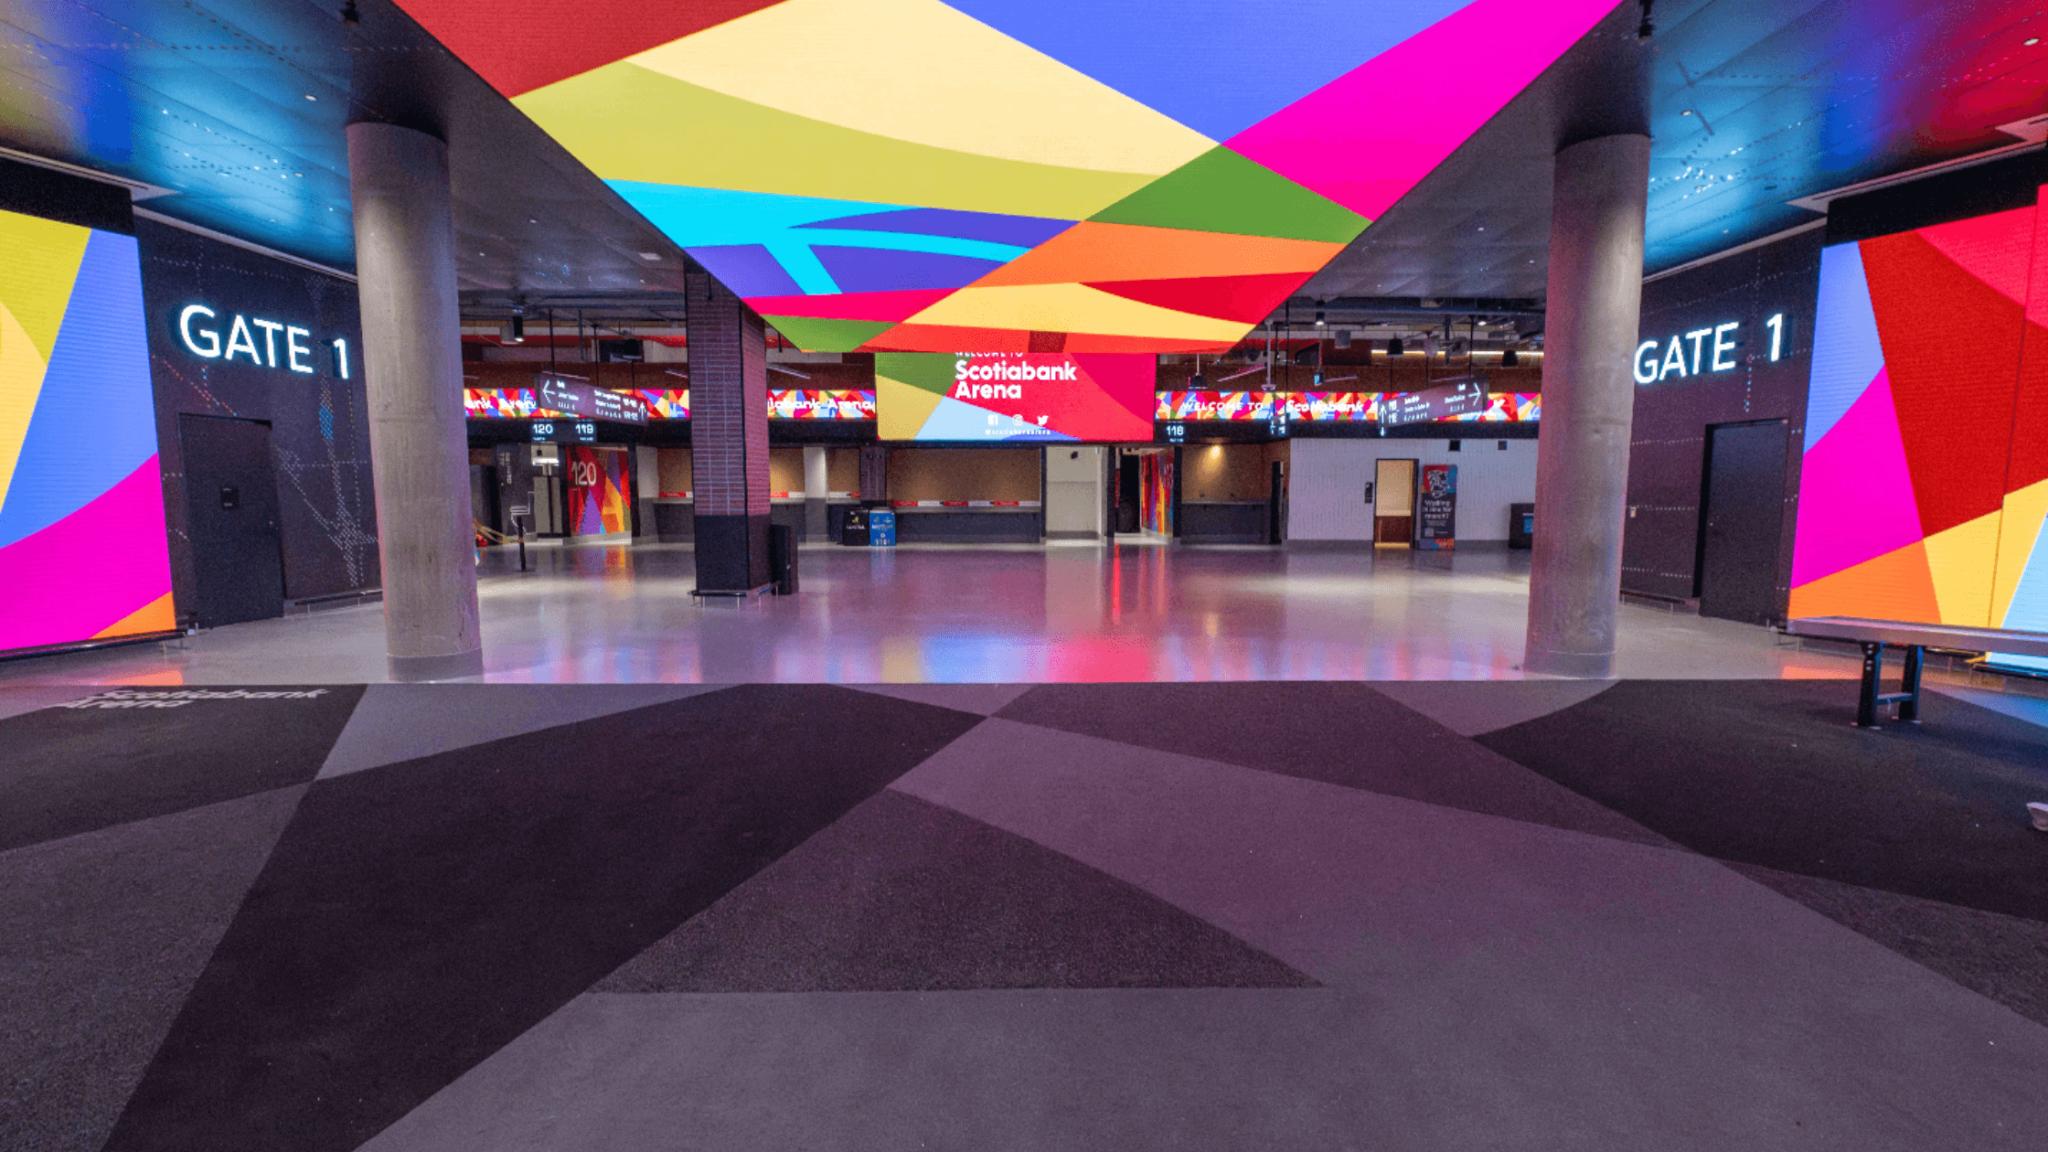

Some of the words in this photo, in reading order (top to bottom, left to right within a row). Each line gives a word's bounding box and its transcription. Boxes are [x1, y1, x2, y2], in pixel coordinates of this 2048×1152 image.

[179, 304, 314, 374] GATE
[332, 338, 349, 380] 1
[1633, 321, 1740, 384] GATE
[1766, 313, 1783, 362] 1
[955, 359, 1077, 380] Scotiabank
[955, 381, 1022, 399] Arena
[828, 398, 873, 410] Arena
[1182, 401, 1244, 411] WELCOME
[1248, 402, 1264, 411] TO
[1286, 399, 1364, 412] Scotiabank
[532, 423, 554, 434] 120
[1166, 425, 1185, 436] 118
[571, 461, 597, 486] 120
[87, 688, 331, 699] Scotiabank
